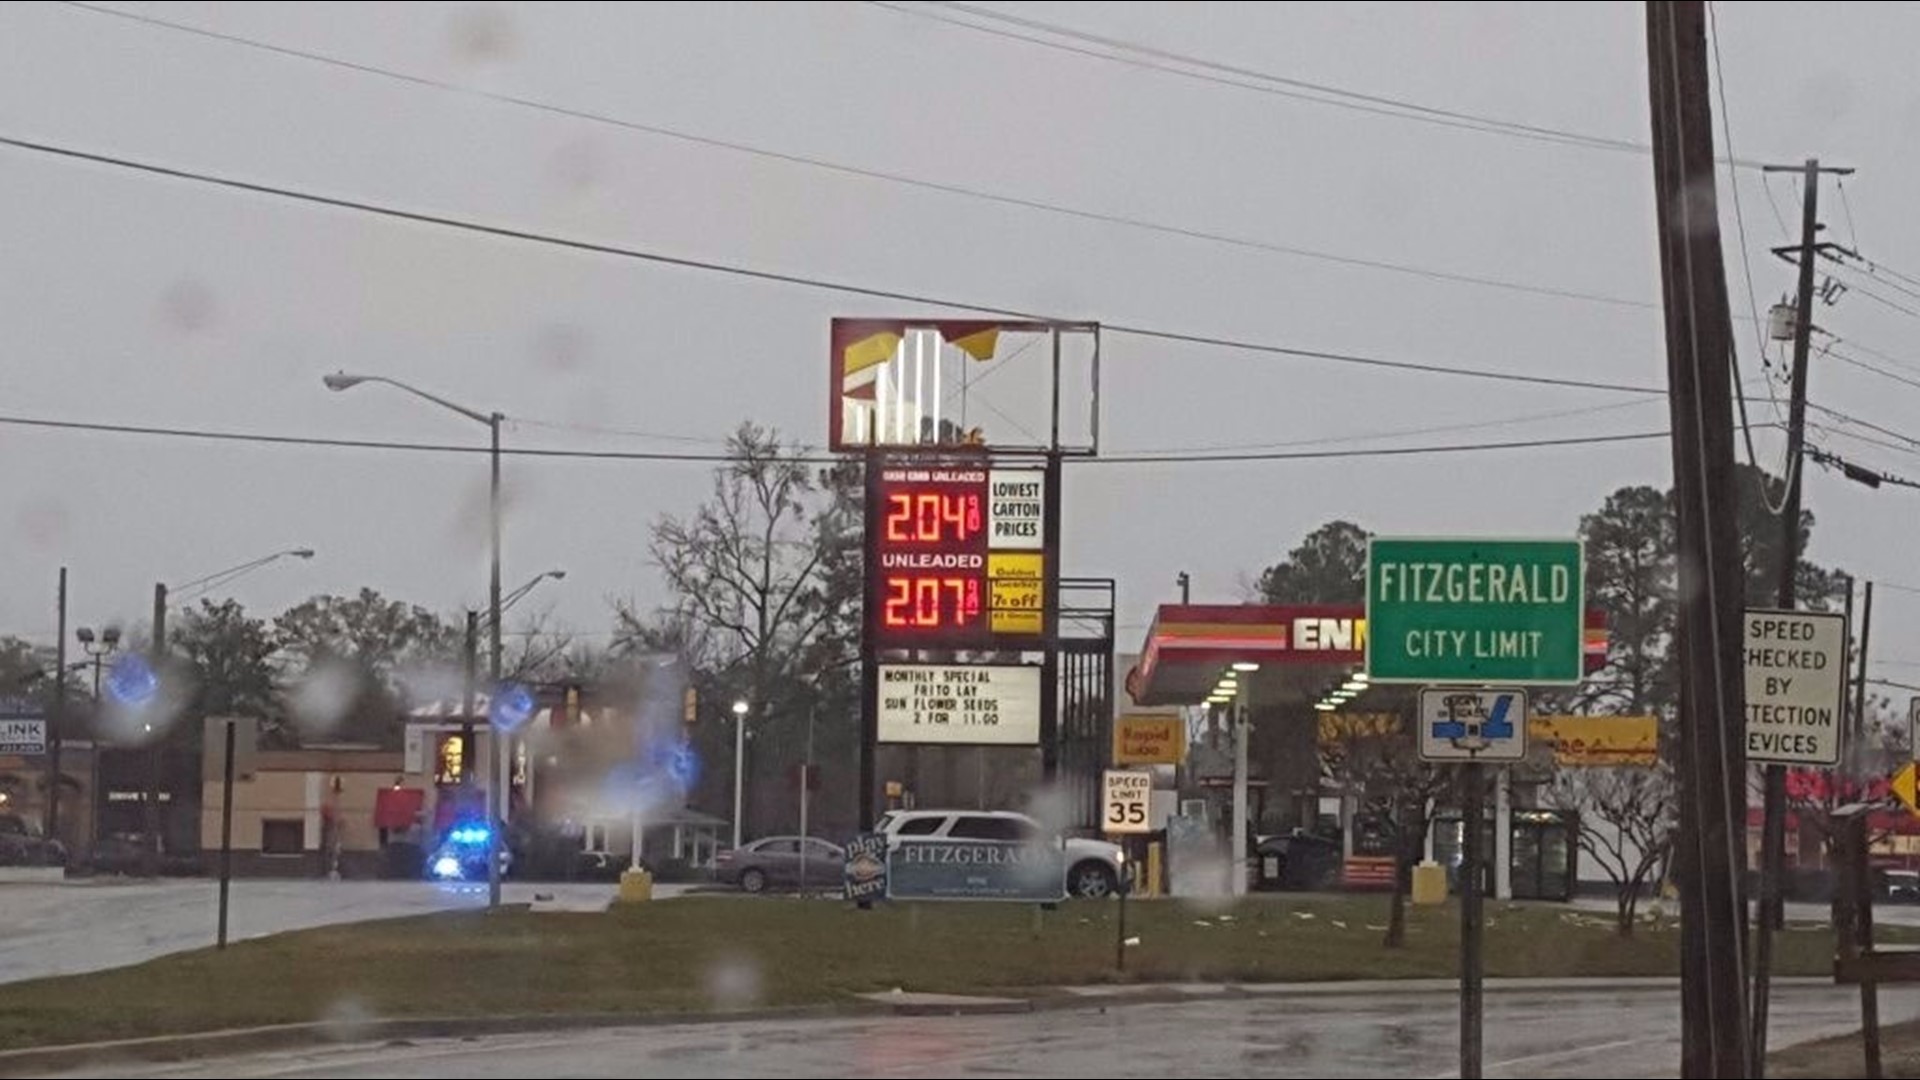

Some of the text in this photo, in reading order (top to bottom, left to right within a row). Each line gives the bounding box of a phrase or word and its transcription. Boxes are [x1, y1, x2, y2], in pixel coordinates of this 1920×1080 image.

[993, 482, 1039, 497] LOWEST
[888, 495, 965, 541] 2.04
[993, 502, 1040, 517] CARTON
[995, 522, 1037, 537] PRICES
[882, 554, 983, 569] UNLEADED
[1379, 562, 1570, 604] FITZGERALD
[886, 579, 965, 626] 2.07
[1010, 594, 1038, 607] off
[1750, 620, 1815, 641] SPEED
[1405, 630, 1543, 659] CITY LIMIT
[1743, 648, 1827, 671] HECKED
[884, 670, 991, 683] MONTHLY SPECIAL
[914, 684, 978, 697] FRITO LAY
[1765, 677, 1793, 696] BY
[884, 697, 999, 711] SUN FLOWER SEEDS
[914, 712, 920, 724] 2
[928, 712, 950, 724] FOR
[1746, 703, 1832, 727] TECTION
[1748, 733, 1818, 754] EVICES
[1108, 776, 1148, 788] SPEED
[1111, 789, 1142, 799] LIMIT
[1108, 801, 1145, 824] 35
[905, 844, 1042, 864] FITZGERA
[846, 878, 885, 898] here
